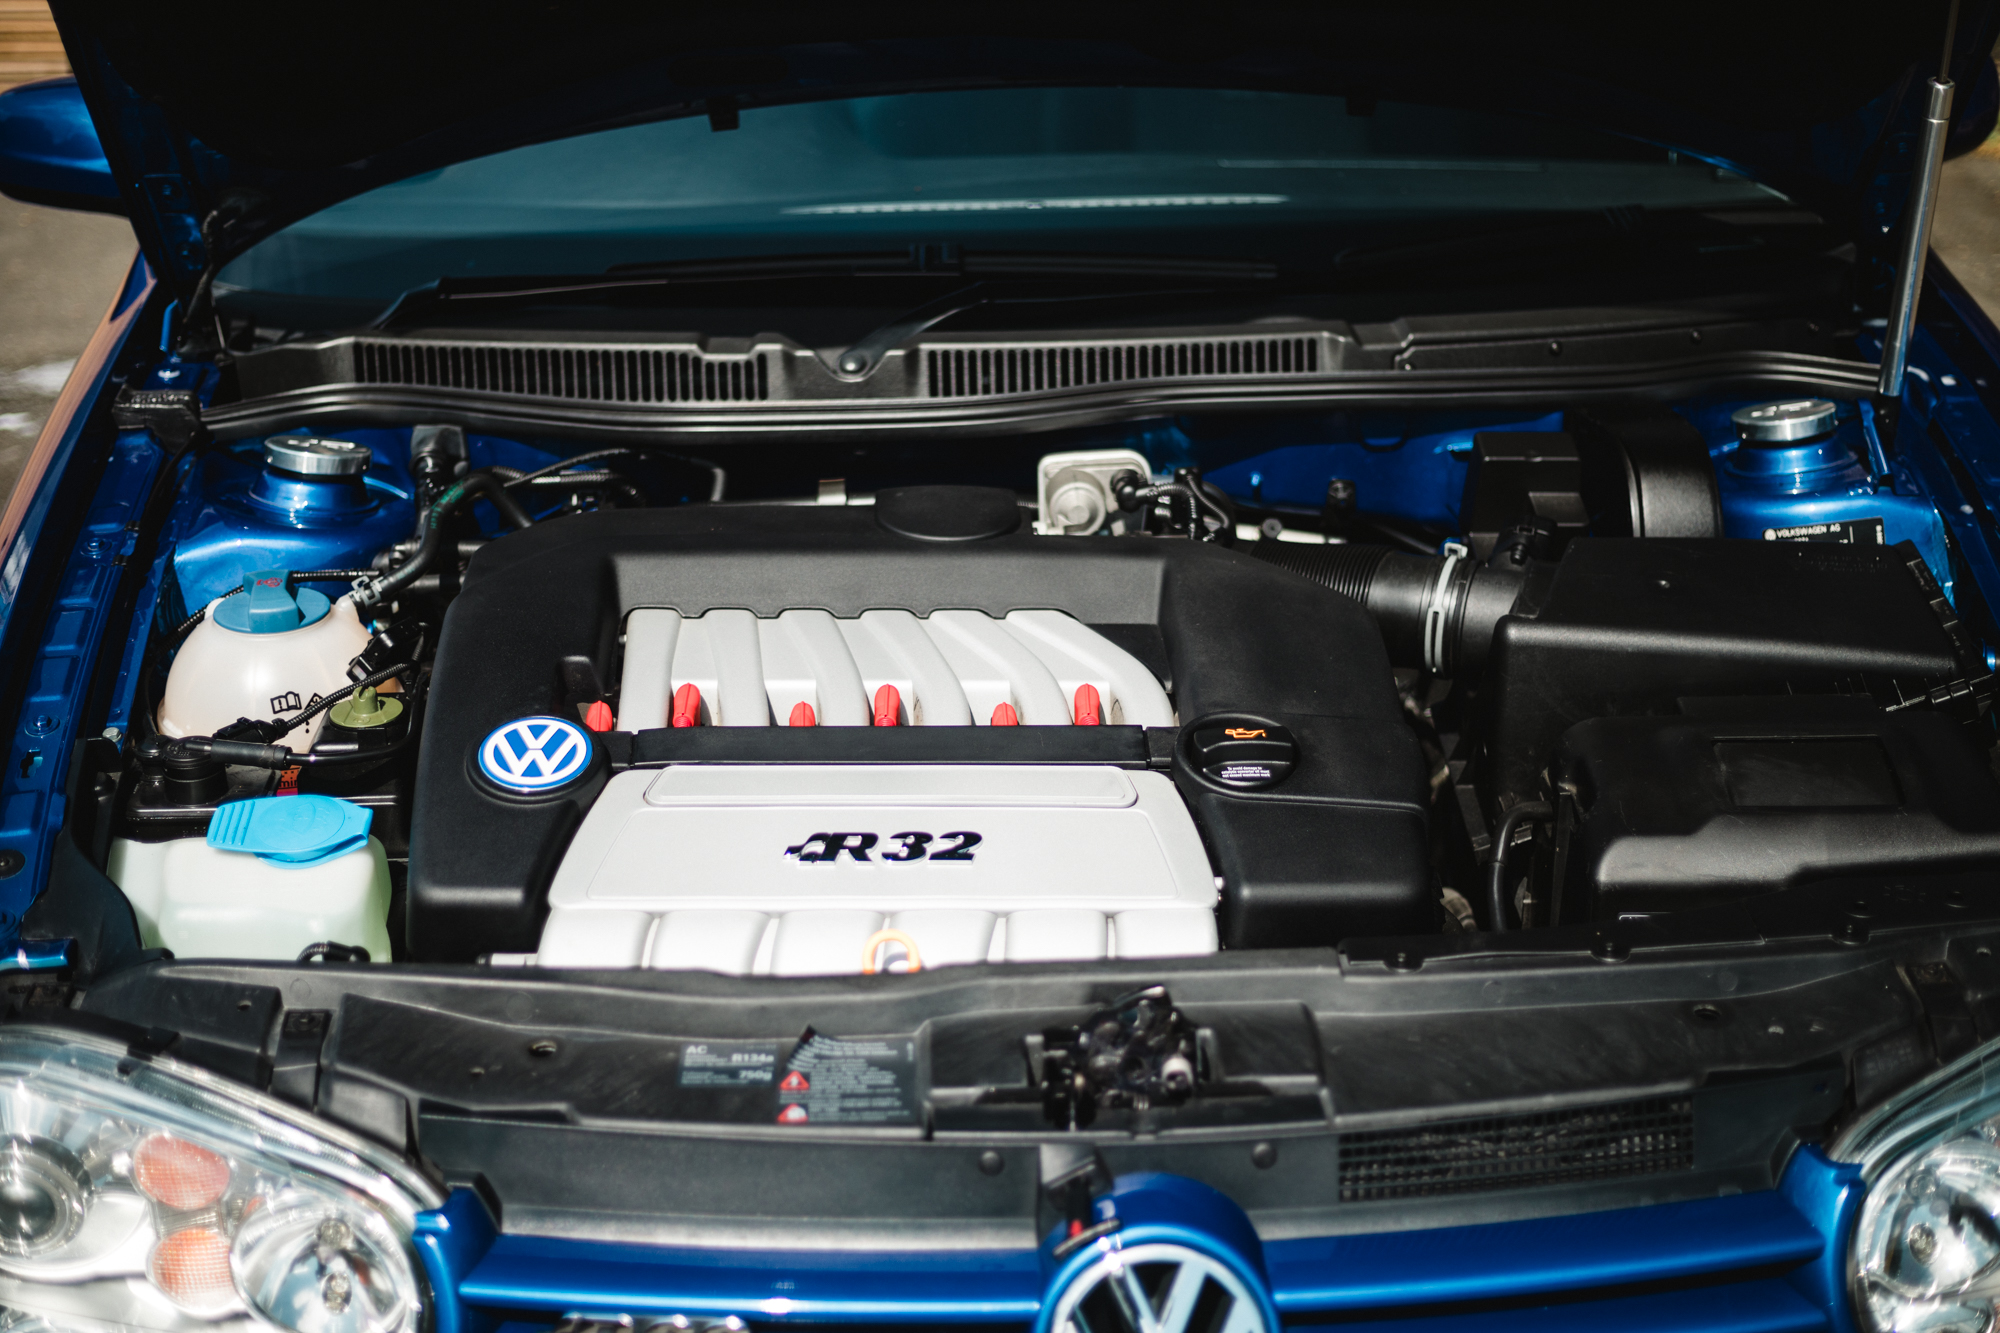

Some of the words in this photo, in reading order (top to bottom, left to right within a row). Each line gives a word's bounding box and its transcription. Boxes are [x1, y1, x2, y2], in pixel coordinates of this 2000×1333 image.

[1777, 525, 1827, 538] VOLKSWAGEN
[1830, 523, 1841, 533] AG
[480, 717, 591, 788] VW
[686, 1045, 708, 1055] AC
[732, 1053, 774, 1064] R134a
[739, 1070, 772, 1081] 750g
